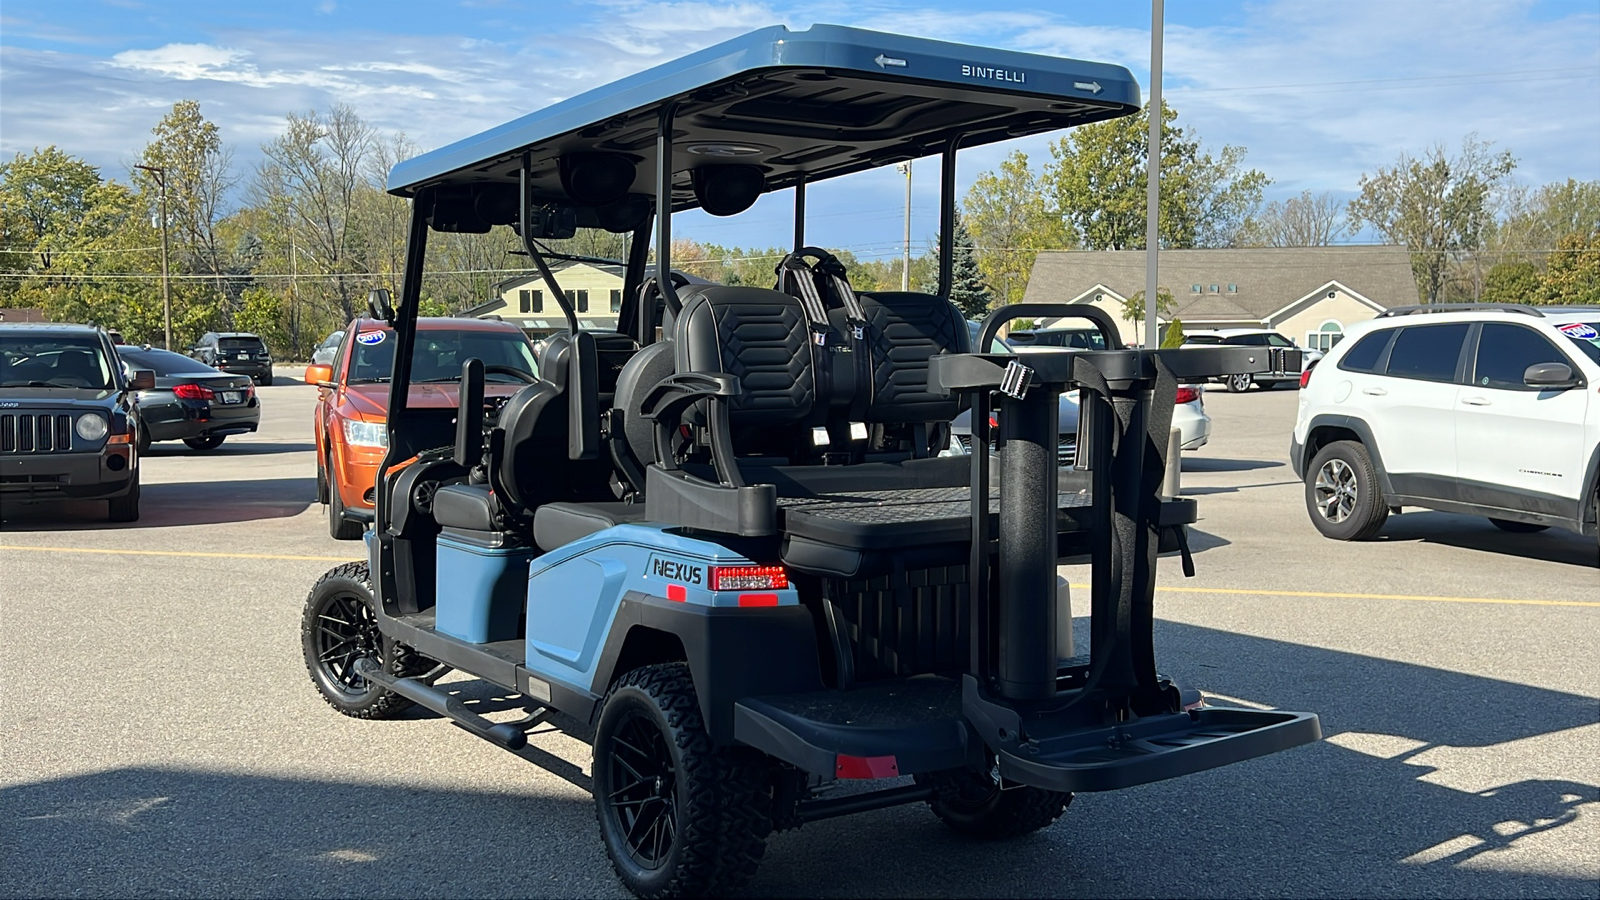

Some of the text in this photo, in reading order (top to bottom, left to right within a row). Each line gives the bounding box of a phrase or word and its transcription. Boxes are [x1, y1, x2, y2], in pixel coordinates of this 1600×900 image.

[962, 65, 1025, 83] BINTELLI
[360, 333, 383, 342] 2011
[653, 558, 702, 585] NEXUS
